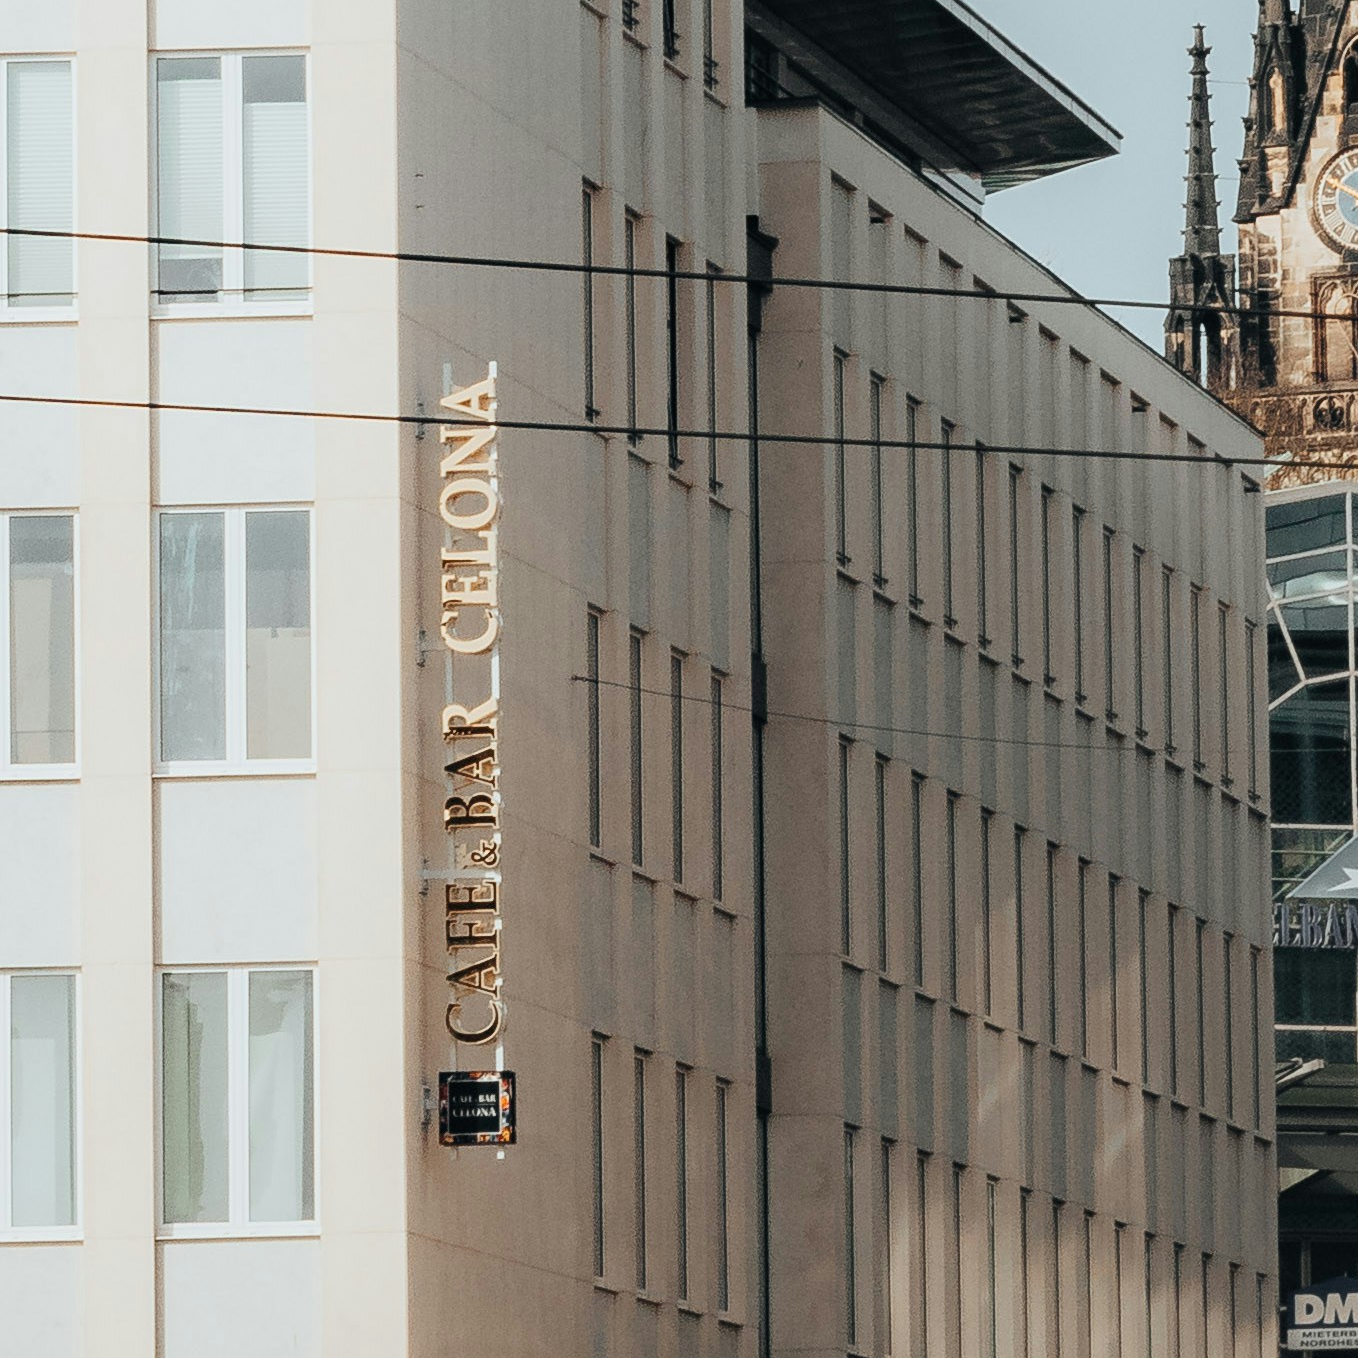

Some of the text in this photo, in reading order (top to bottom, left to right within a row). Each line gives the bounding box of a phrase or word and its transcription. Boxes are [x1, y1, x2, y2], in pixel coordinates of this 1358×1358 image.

[439, 376, 499, 655] CELONA
[442, 696, 500, 832] BAR
[471, 839, 500, 866] &
